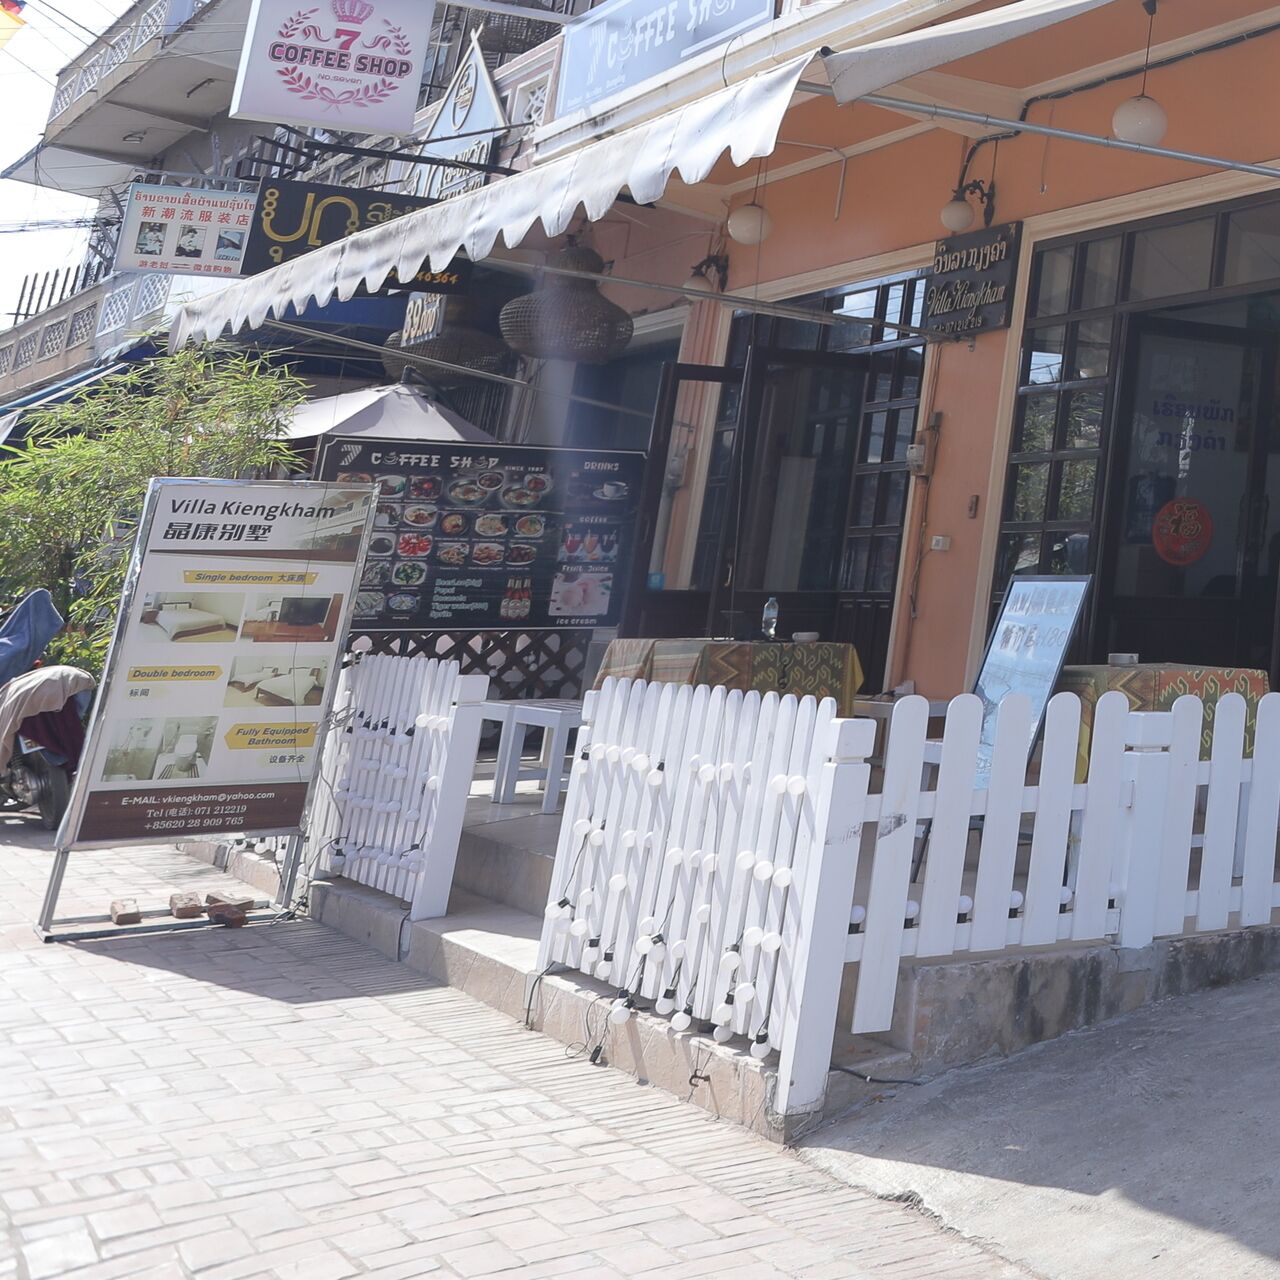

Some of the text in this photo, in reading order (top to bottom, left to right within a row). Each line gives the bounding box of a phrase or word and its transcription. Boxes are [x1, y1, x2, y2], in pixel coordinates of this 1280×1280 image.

[335, 28, 362, 51] 7
[269, 41, 413, 79] COFFEE SHOP
[141, 205, 250, 226] 新潮流服装店
[926, 281, 951, 317] Villa
[584, 461, 620, 471] DRINKS
[171, 499, 335, 521] Villa Kiengkham
[163, 521, 273, 542] 晶康别墅
[194, 572, 226, 584] Single
[229, 573, 273, 583] bedroom
[132, 669, 215, 678] Double bedroom
[236, 727, 310, 737] Fully Equipped
[247, 737, 297, 746] Bathroom
[269, 754, 305, 764] 设备齐全
[121, 791, 275, 806] E-MAIL: vkiengkham@yahoo.com
[146, 809, 164, 818] Tel
[194, 807, 211, 816] 071
[213, 805, 247, 815] 212219
[144, 817, 244, 831] +85620 28 909 765
